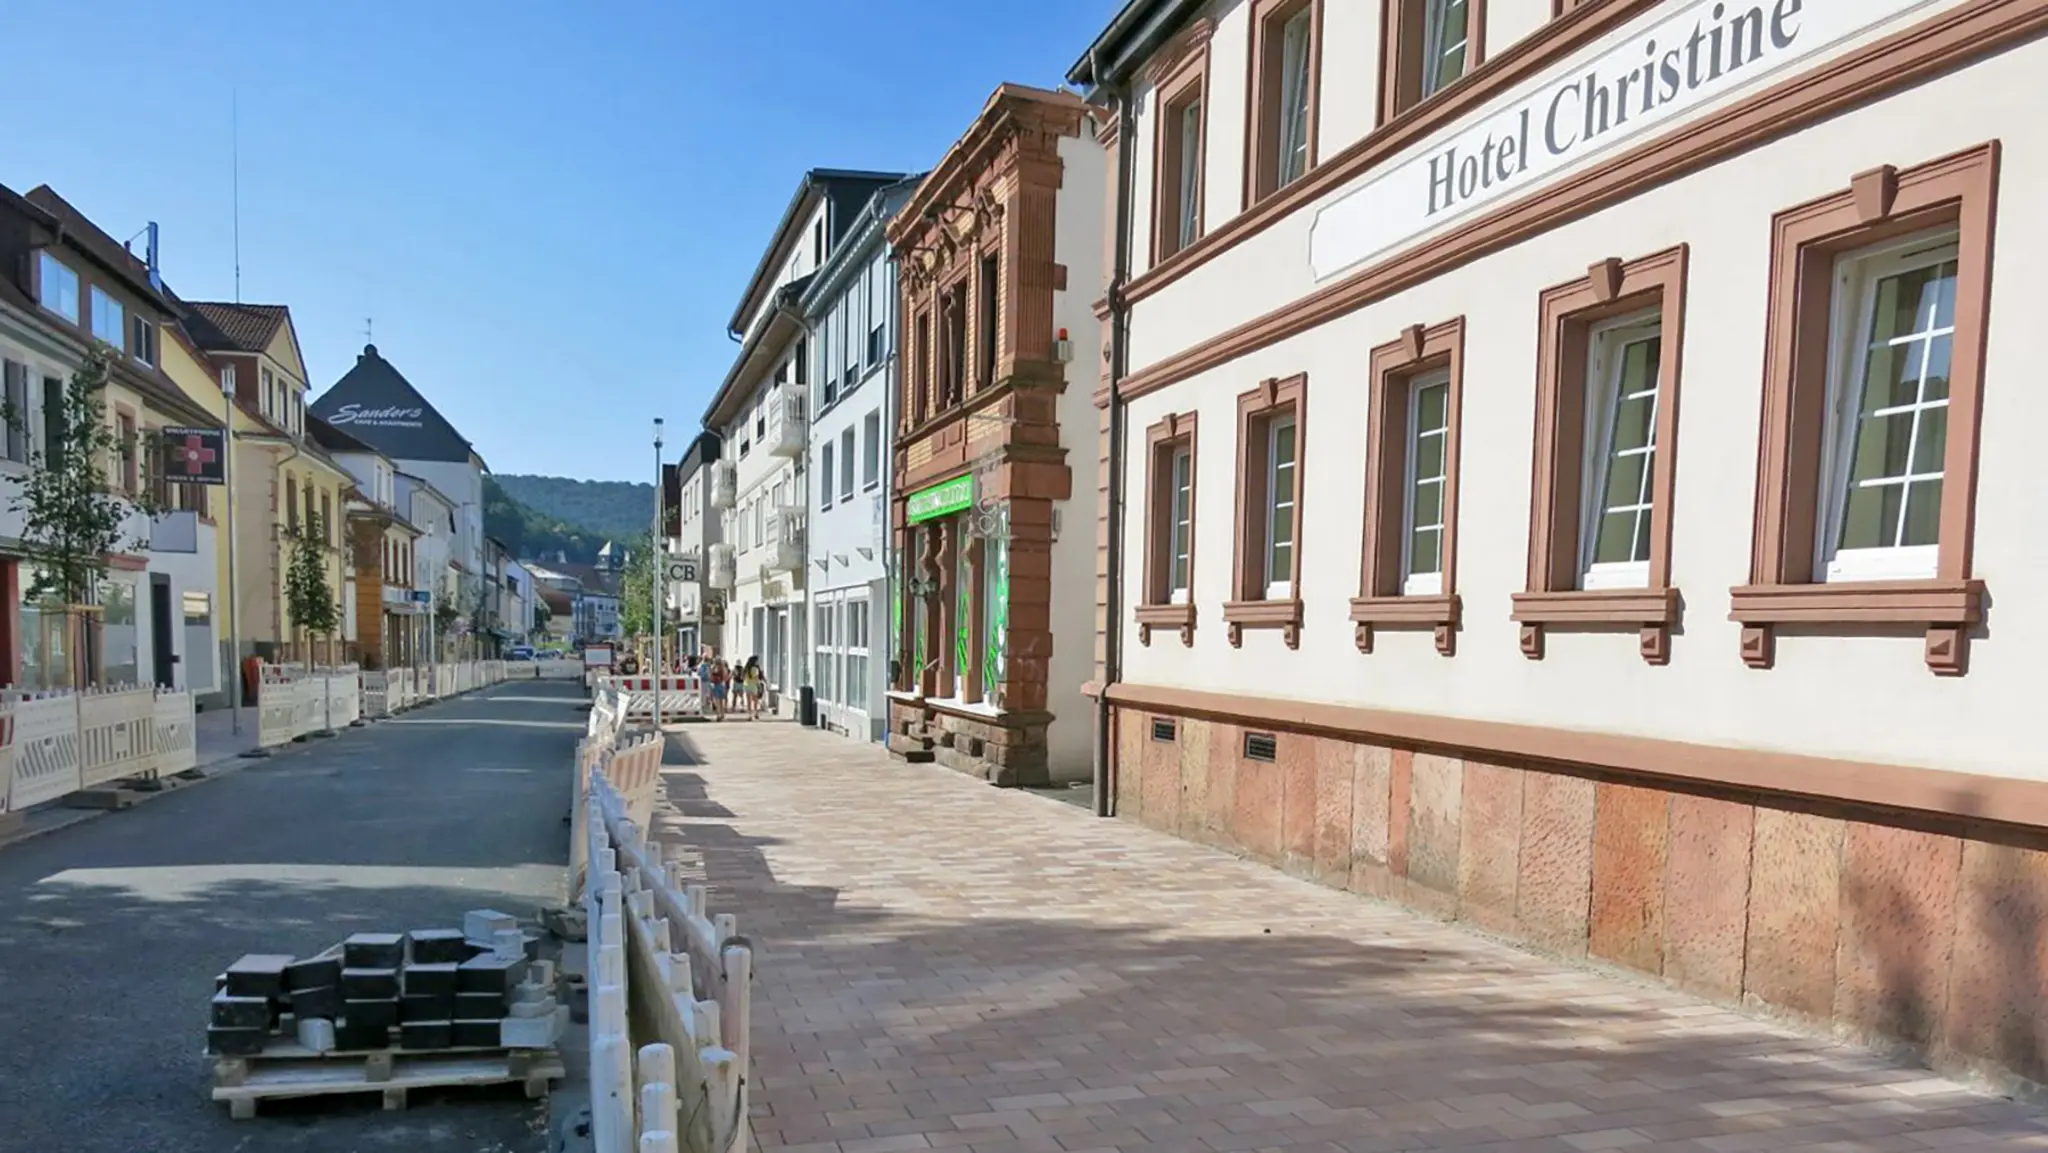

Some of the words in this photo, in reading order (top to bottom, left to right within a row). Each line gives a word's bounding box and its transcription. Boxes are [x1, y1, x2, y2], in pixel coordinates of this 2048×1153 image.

[1426, 109, 1528, 217] Hotel
[1544, 0, 1802, 156] Christine
[328, 404, 422, 424] Sanders
[670, 564, 695, 580] CB
